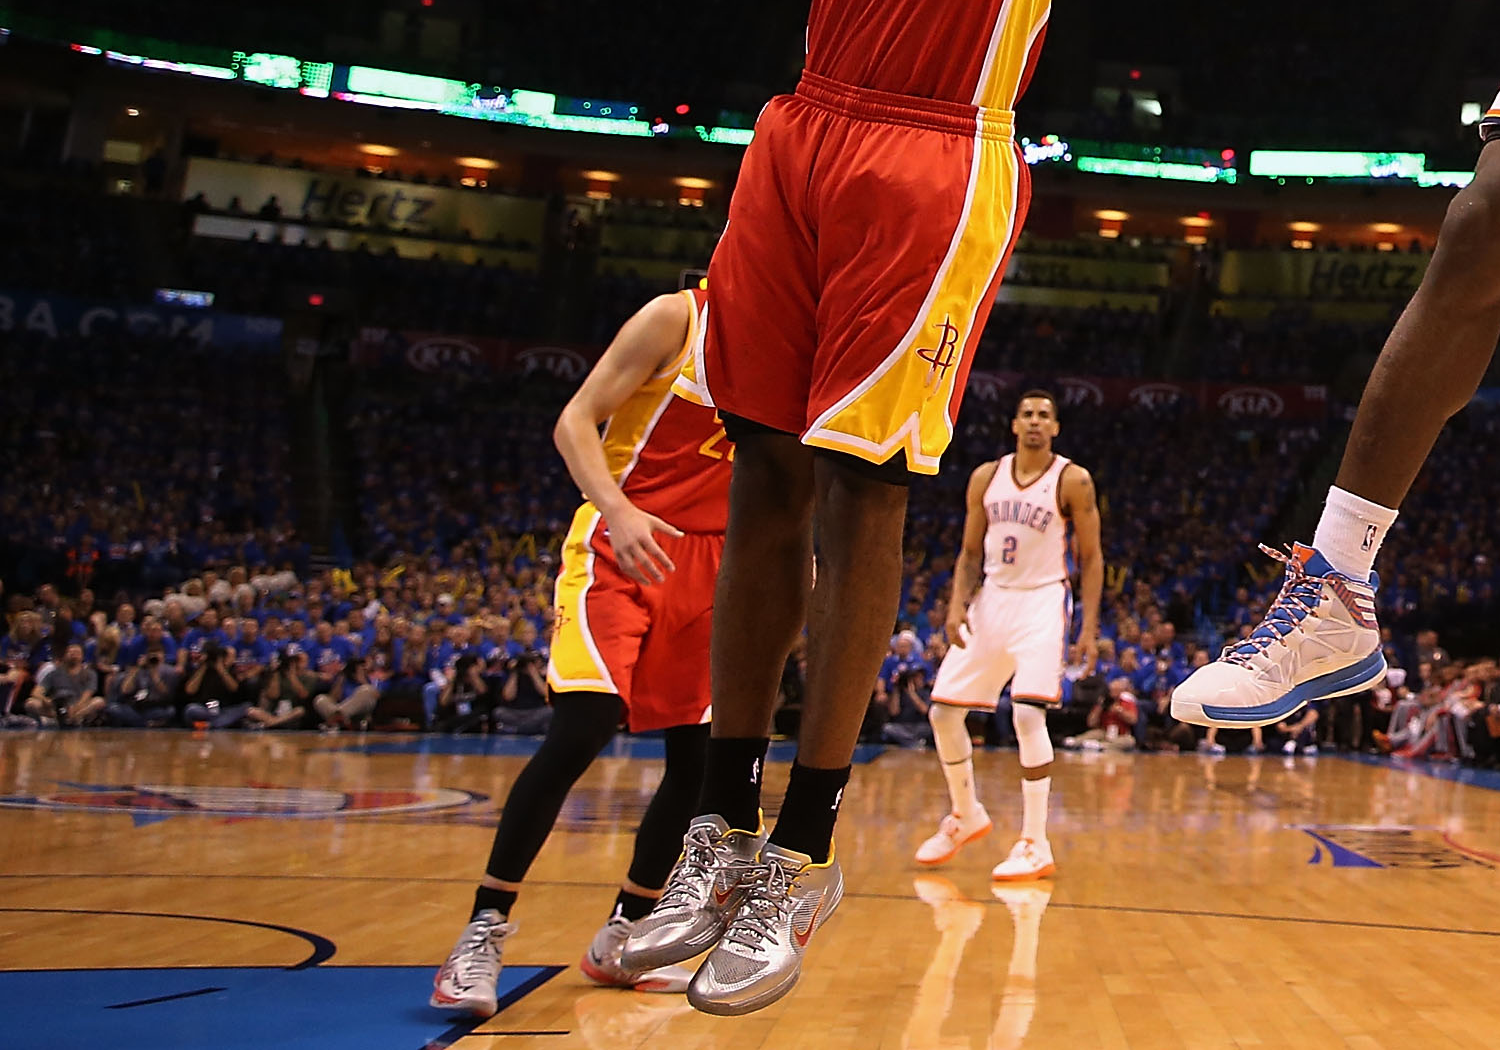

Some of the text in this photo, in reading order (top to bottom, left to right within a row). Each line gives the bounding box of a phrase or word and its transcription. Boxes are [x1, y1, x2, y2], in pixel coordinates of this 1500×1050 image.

[302, 178, 437, 227] Hertz
[1309, 258, 1418, 296] Hertz
[986, 499, 1055, 534] THUNDER
[1001, 535, 1018, 565] 2
